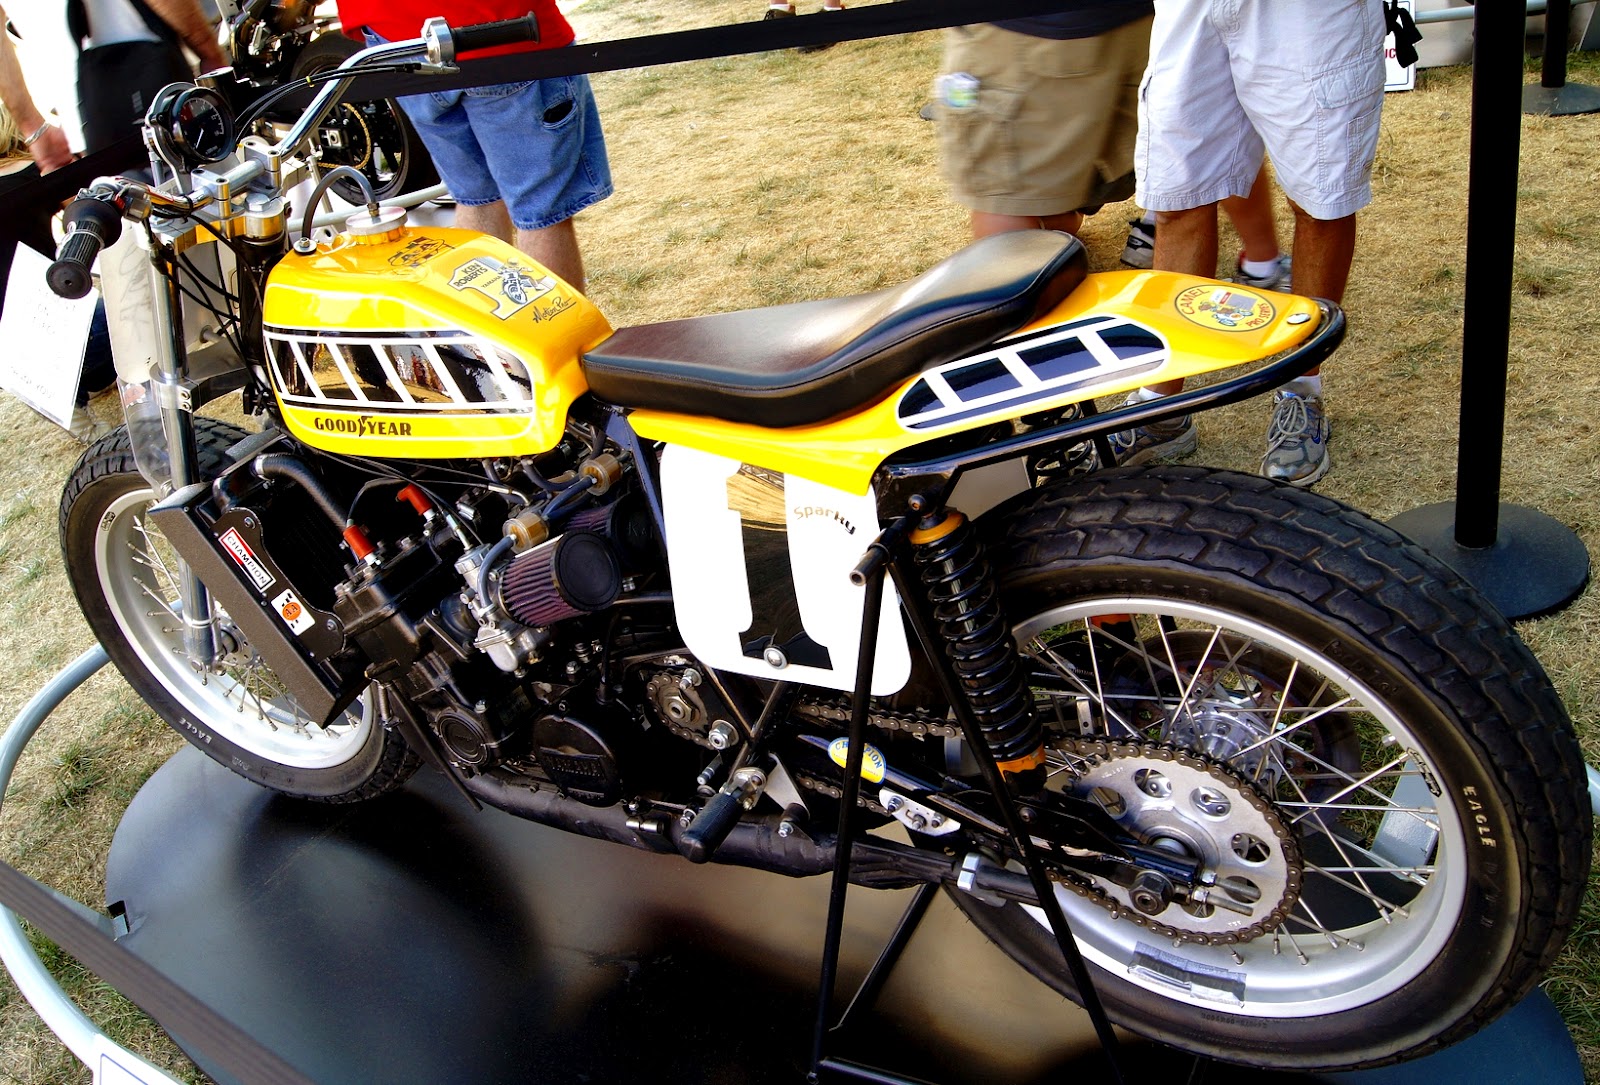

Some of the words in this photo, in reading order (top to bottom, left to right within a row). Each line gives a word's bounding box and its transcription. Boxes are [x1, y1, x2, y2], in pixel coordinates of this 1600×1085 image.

[453, 265, 489, 288] ROBERTS
[462, 262, 481, 275] KEN
[1180, 288, 1210, 315] CAMEL
[1246, 317, 1265, 328] PRO
[314, 415, 412, 437] GOODYEAR
[793, 506, 856, 535] Sparky
[227, 536, 267, 584] CHAMPION
[178, 717, 212, 744] EAGLE
[835, 741, 883, 769] CHPION
[1462, 785, 1497, 848] EAGLE
